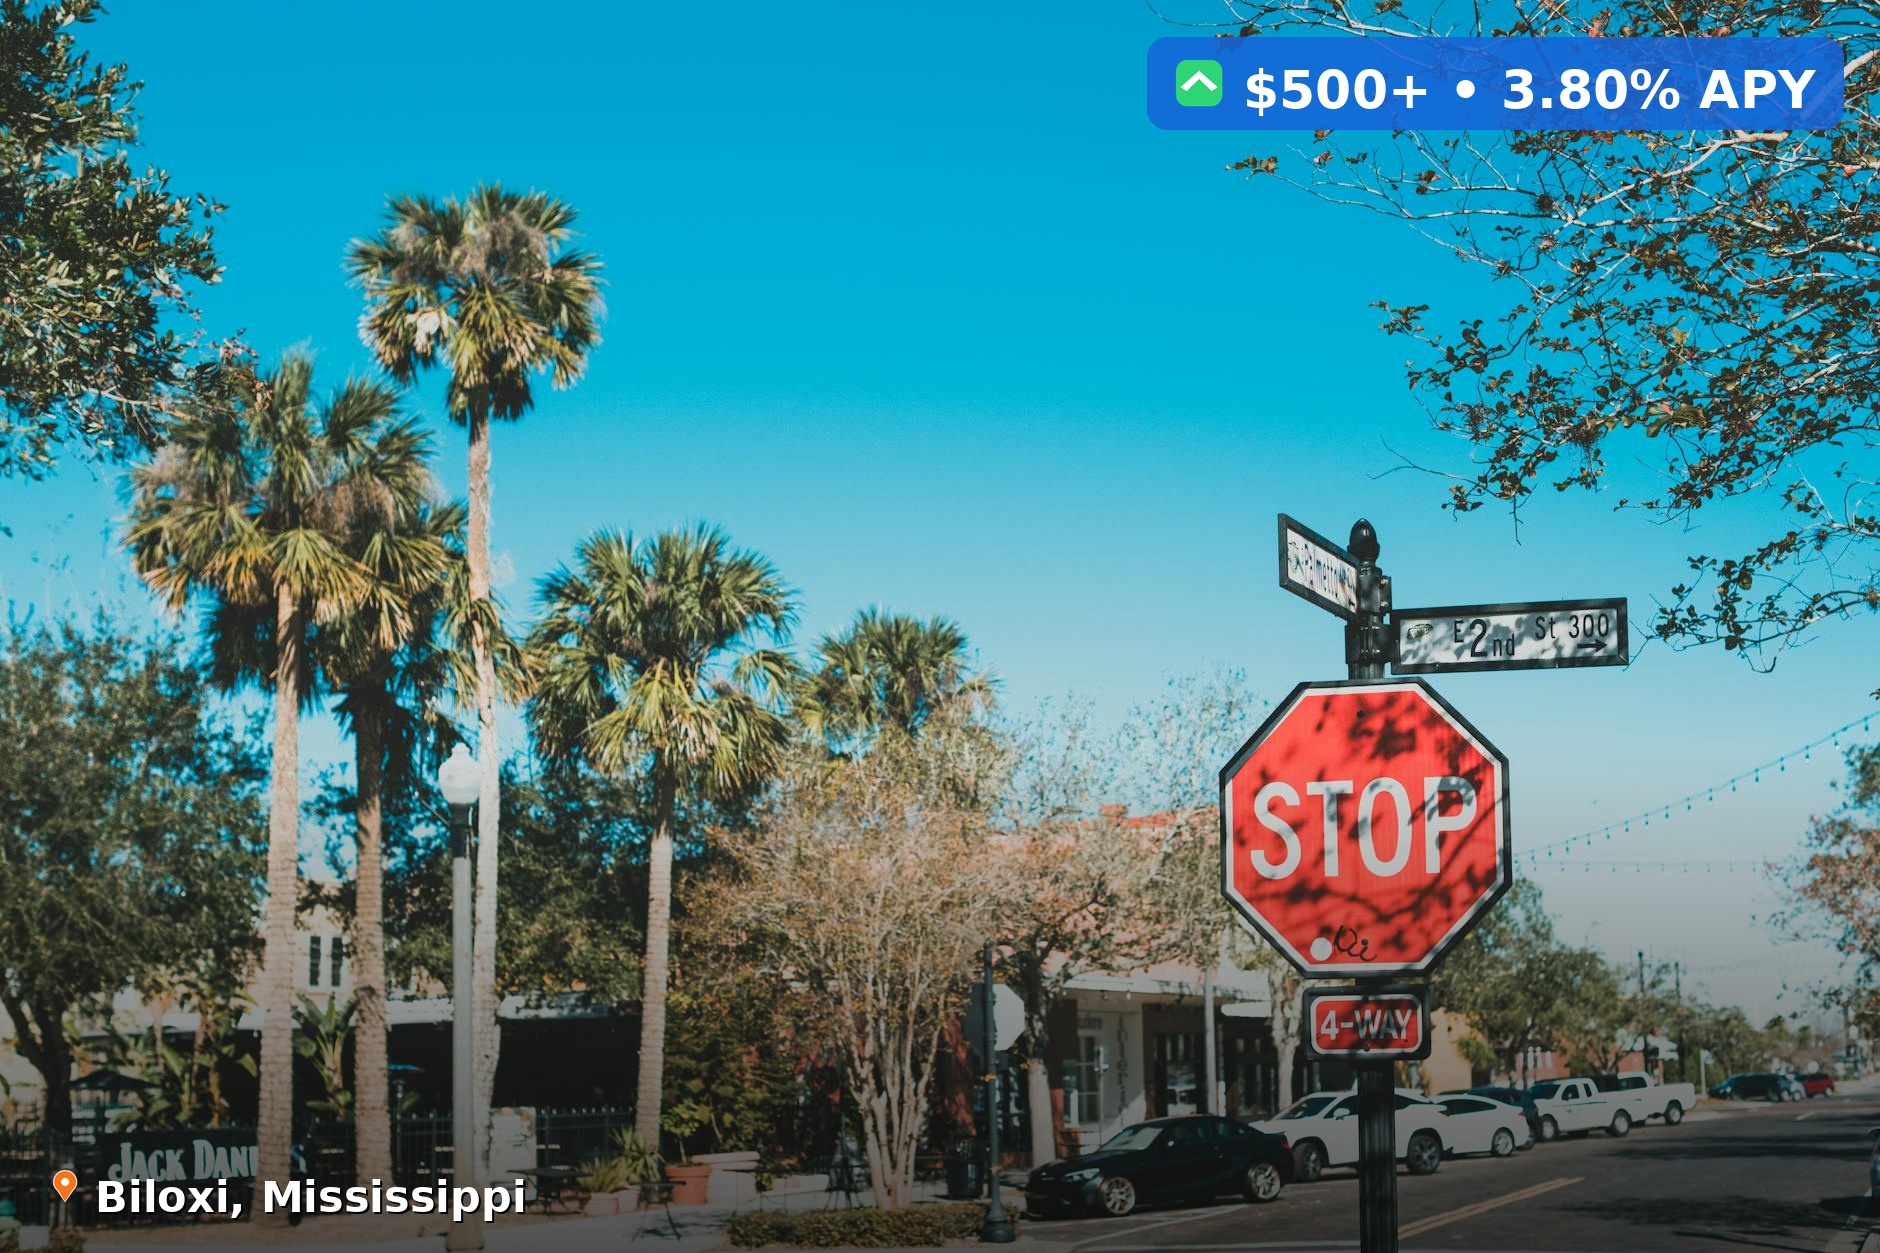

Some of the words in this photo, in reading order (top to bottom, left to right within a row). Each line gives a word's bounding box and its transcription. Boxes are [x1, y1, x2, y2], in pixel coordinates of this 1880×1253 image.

[1304, 543, 1339, 600] Palmetto
[1454, 621, 1464, 643] E
[1470, 619, 1515, 658] 2nd
[1535, 616, 1556, 641] St
[1568, 613, 1609, 639] 300
[1250, 776, 1478, 880] STOP
[1320, 1008, 1413, 1040] 4-WAY
[108, 1141, 188, 1183] JACK
